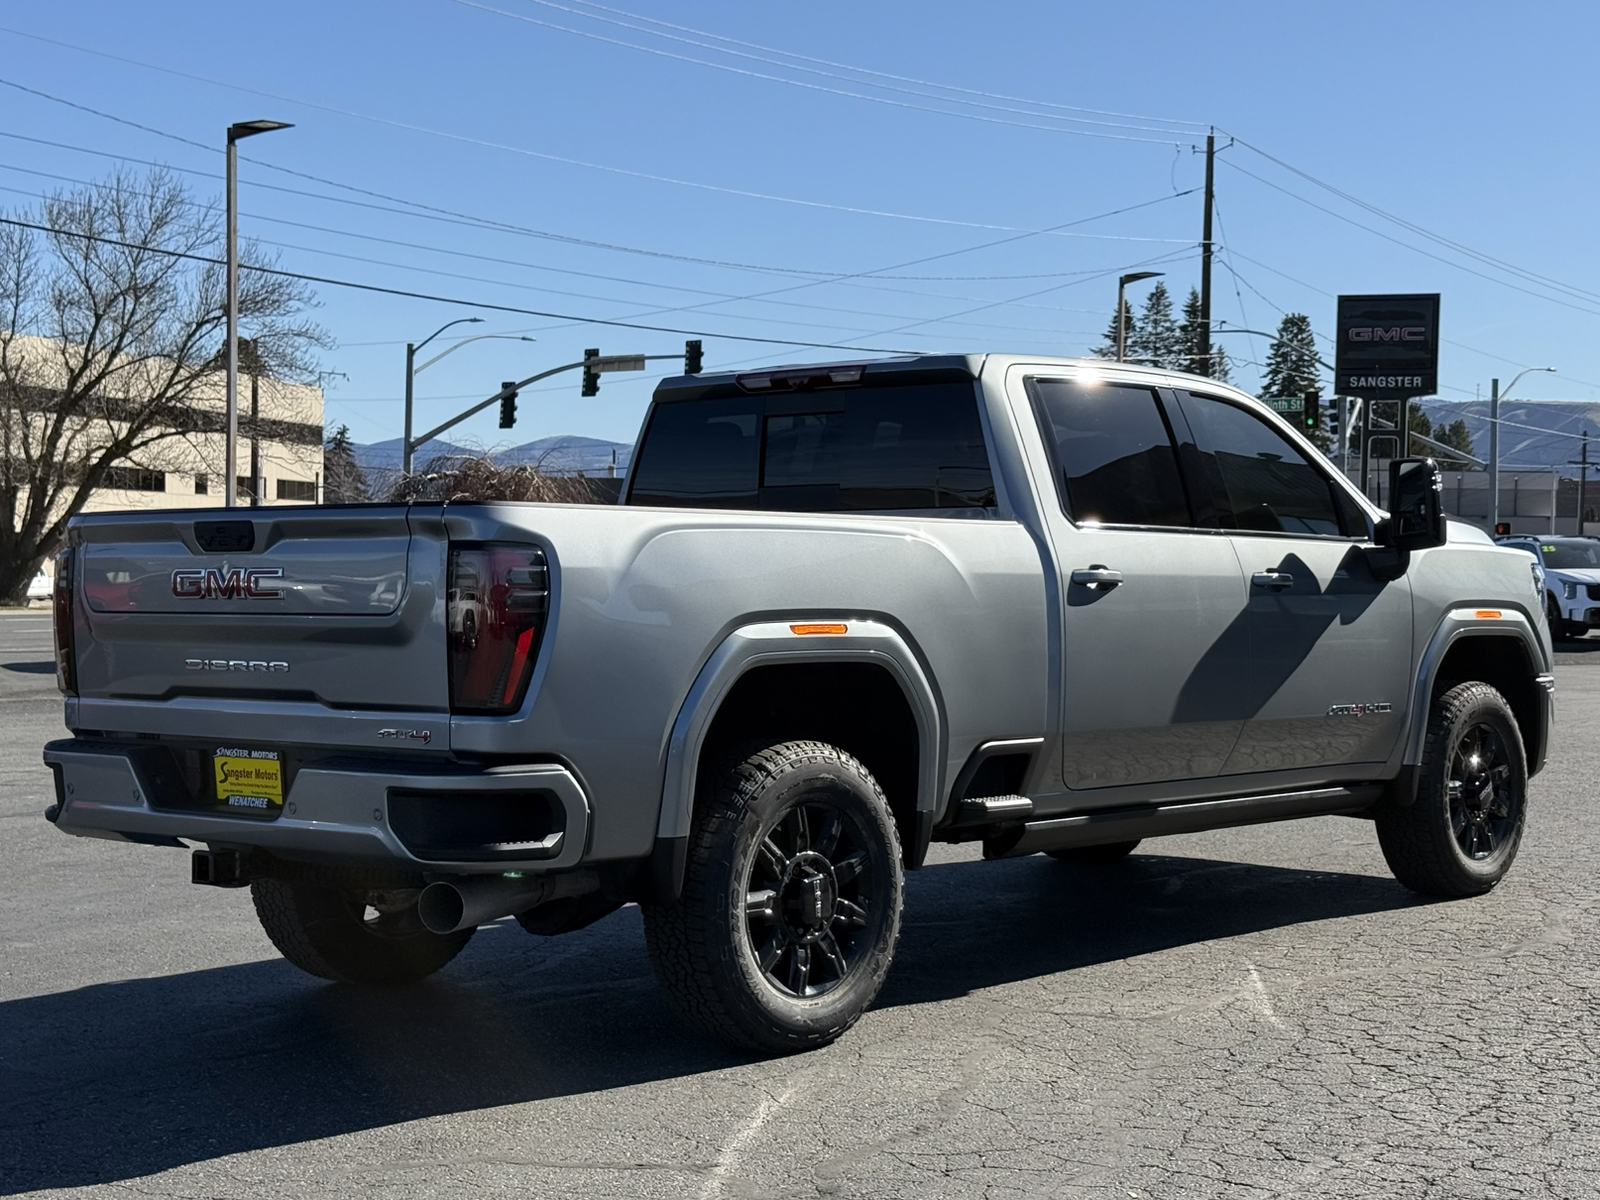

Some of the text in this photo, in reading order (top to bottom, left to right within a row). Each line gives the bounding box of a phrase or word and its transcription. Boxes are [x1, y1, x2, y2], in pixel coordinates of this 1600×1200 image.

[1348, 327, 1425, 341] GMC
[1349, 376, 1422, 388] SANGSTER
[1290, 399, 1301, 410] St
[171, 568, 284, 599] GMC
[185, 659, 291, 673] SIERRA
[377, 728, 431, 745] AT4
[213, 747, 278, 760] SANGSTER MOTORS
[219, 761, 278, 784] Sangster Motors
[229, 796, 268, 808] WENATCHEE
